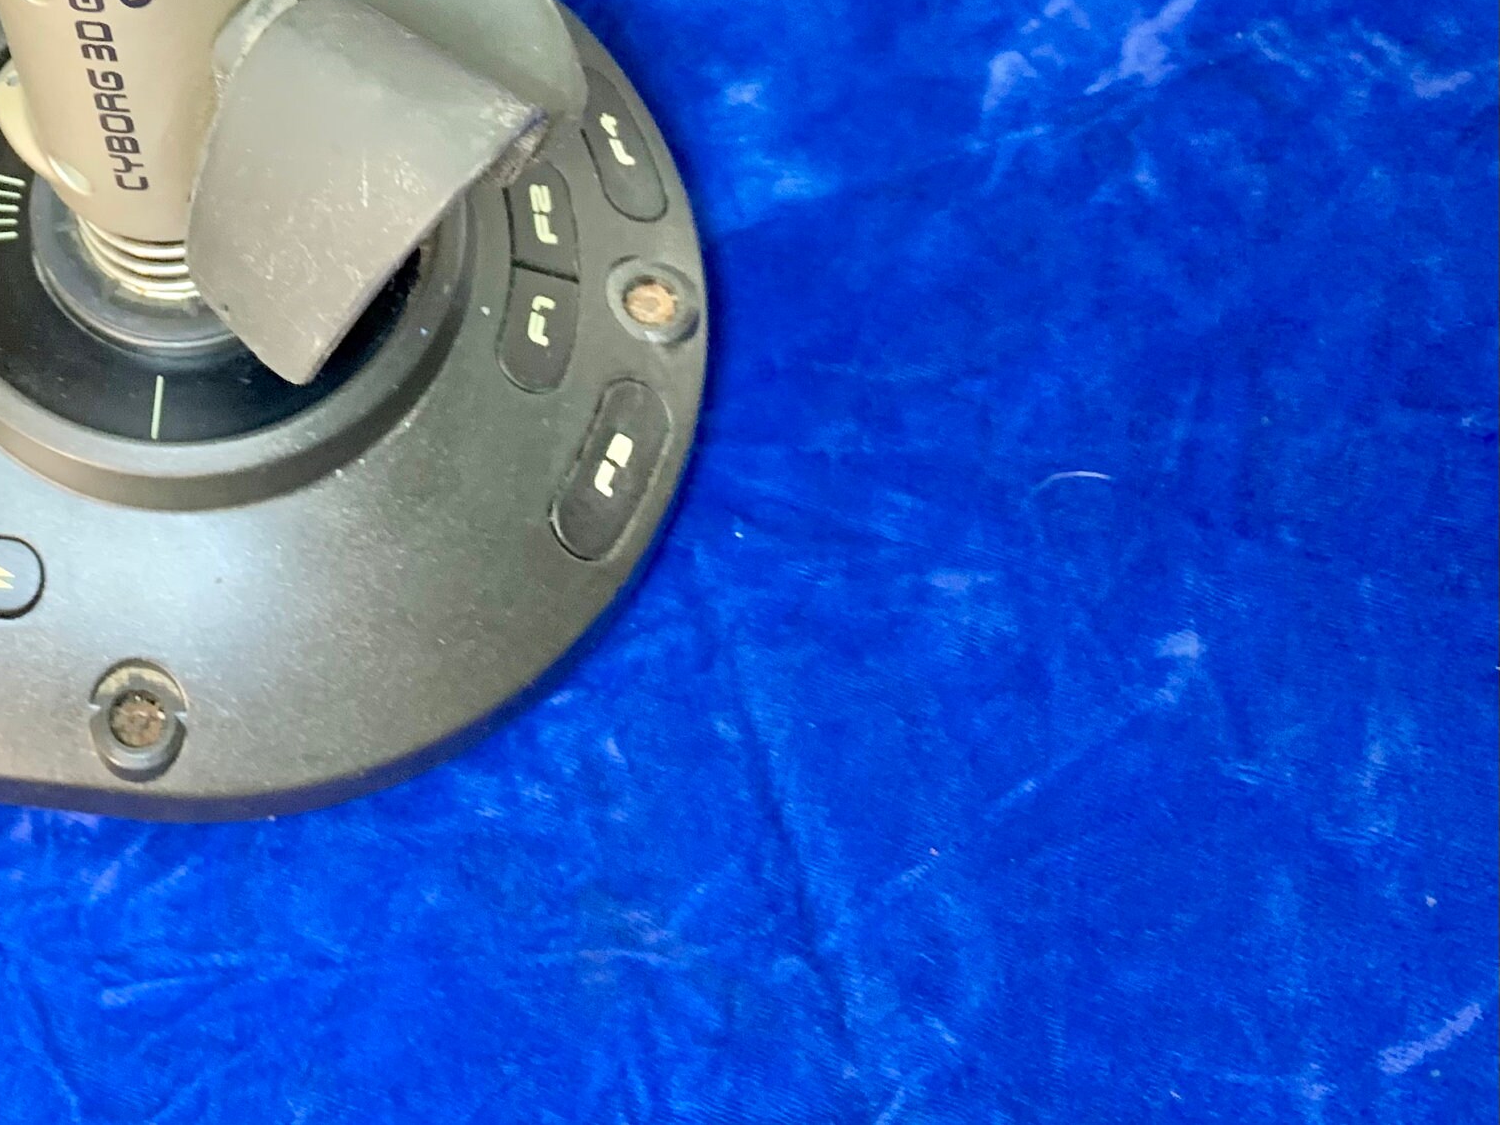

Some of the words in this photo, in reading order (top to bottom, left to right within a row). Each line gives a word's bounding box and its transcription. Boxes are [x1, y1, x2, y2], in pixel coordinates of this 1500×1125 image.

[74, 20, 118, 62] 3D
[87, 69, 149, 192] CYBORG
[600, 113, 635, 166] F4
[529, 184, 558, 245] F2
[527, 295, 555, 346] F1
